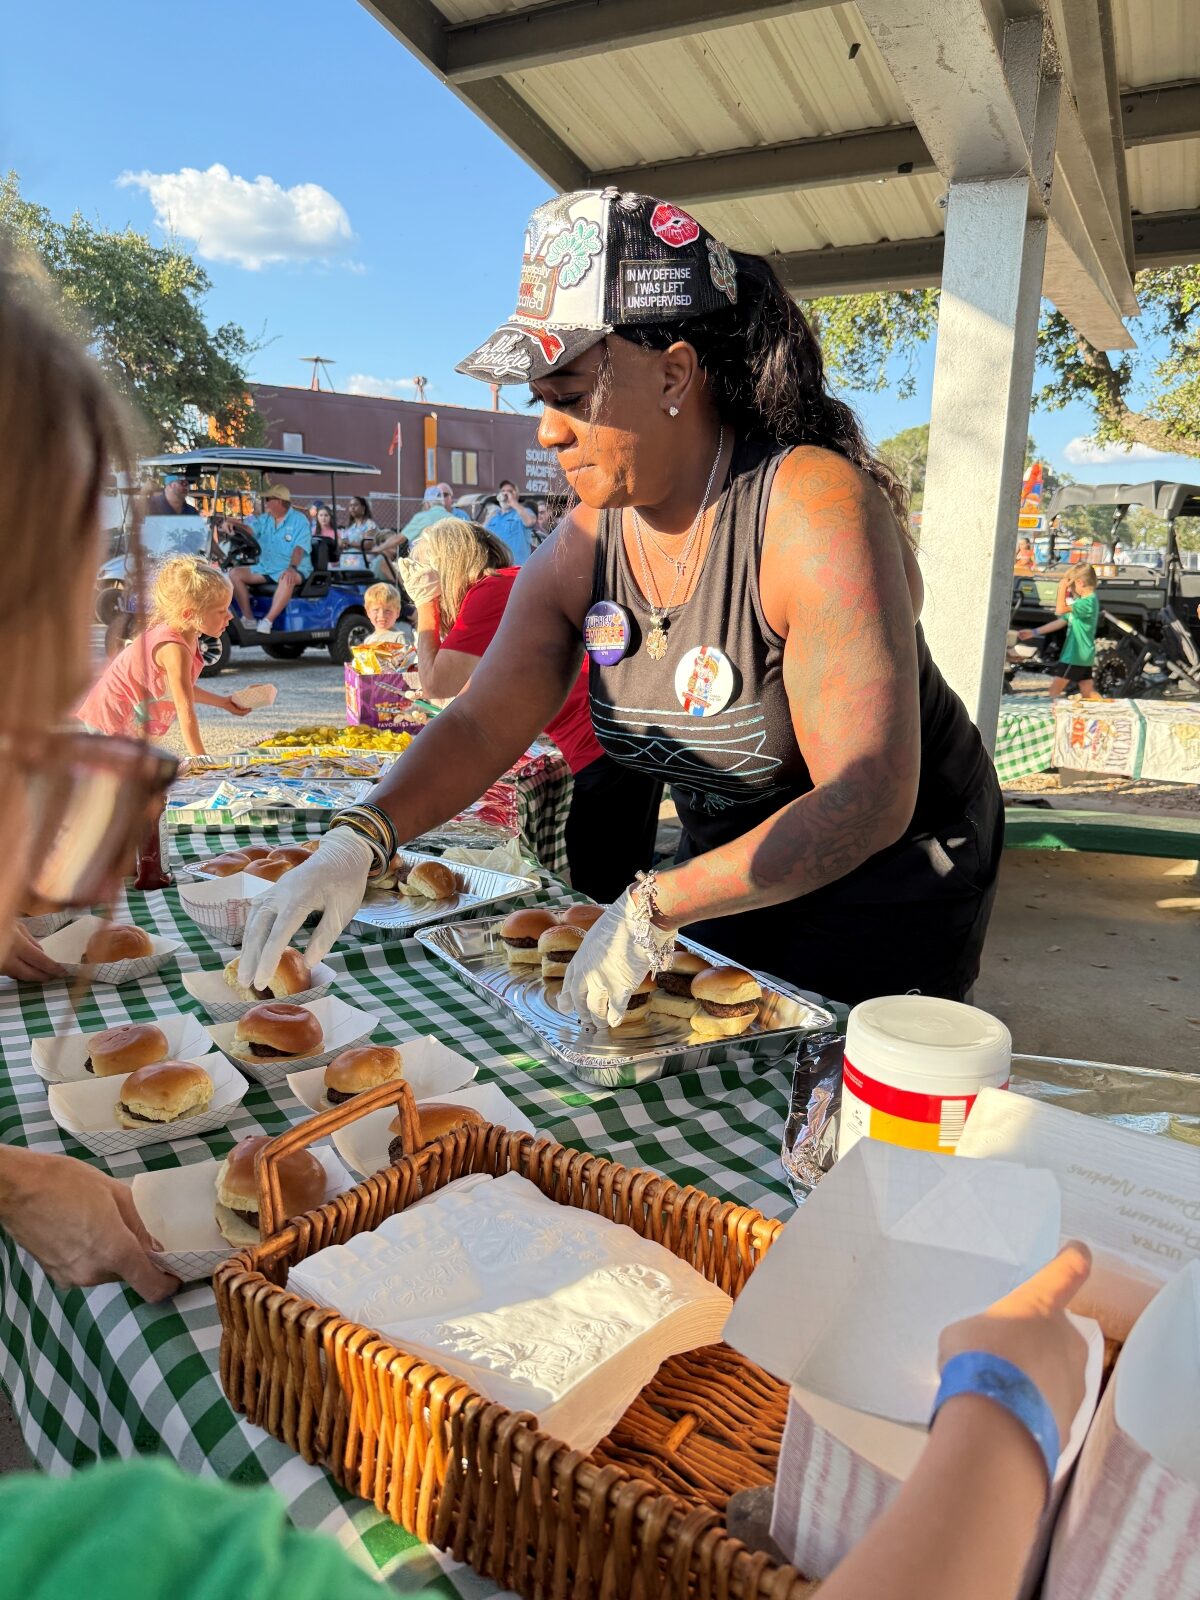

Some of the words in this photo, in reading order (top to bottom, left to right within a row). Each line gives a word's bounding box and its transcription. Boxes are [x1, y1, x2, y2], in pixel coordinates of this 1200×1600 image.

[627, 269, 637, 281] IN
[637, 268, 652, 280] MY
[653, 267, 691, 280] DEFENSE
[640, 283, 661, 294] WAS
[662, 281, 685, 293] LEFT
[626, 294, 692, 308] UNSUPERVISED
[526, 465, 557, 478] PACIFIC
[525, 479, 549, 492] 4672
[1066, 1163, 1137, 1197] Napkins
[1140, 1186, 1200, 1221] Dinner
[1117, 1205, 1200, 1250] Premium
[1132, 1233, 1184, 1261] ULTRA
